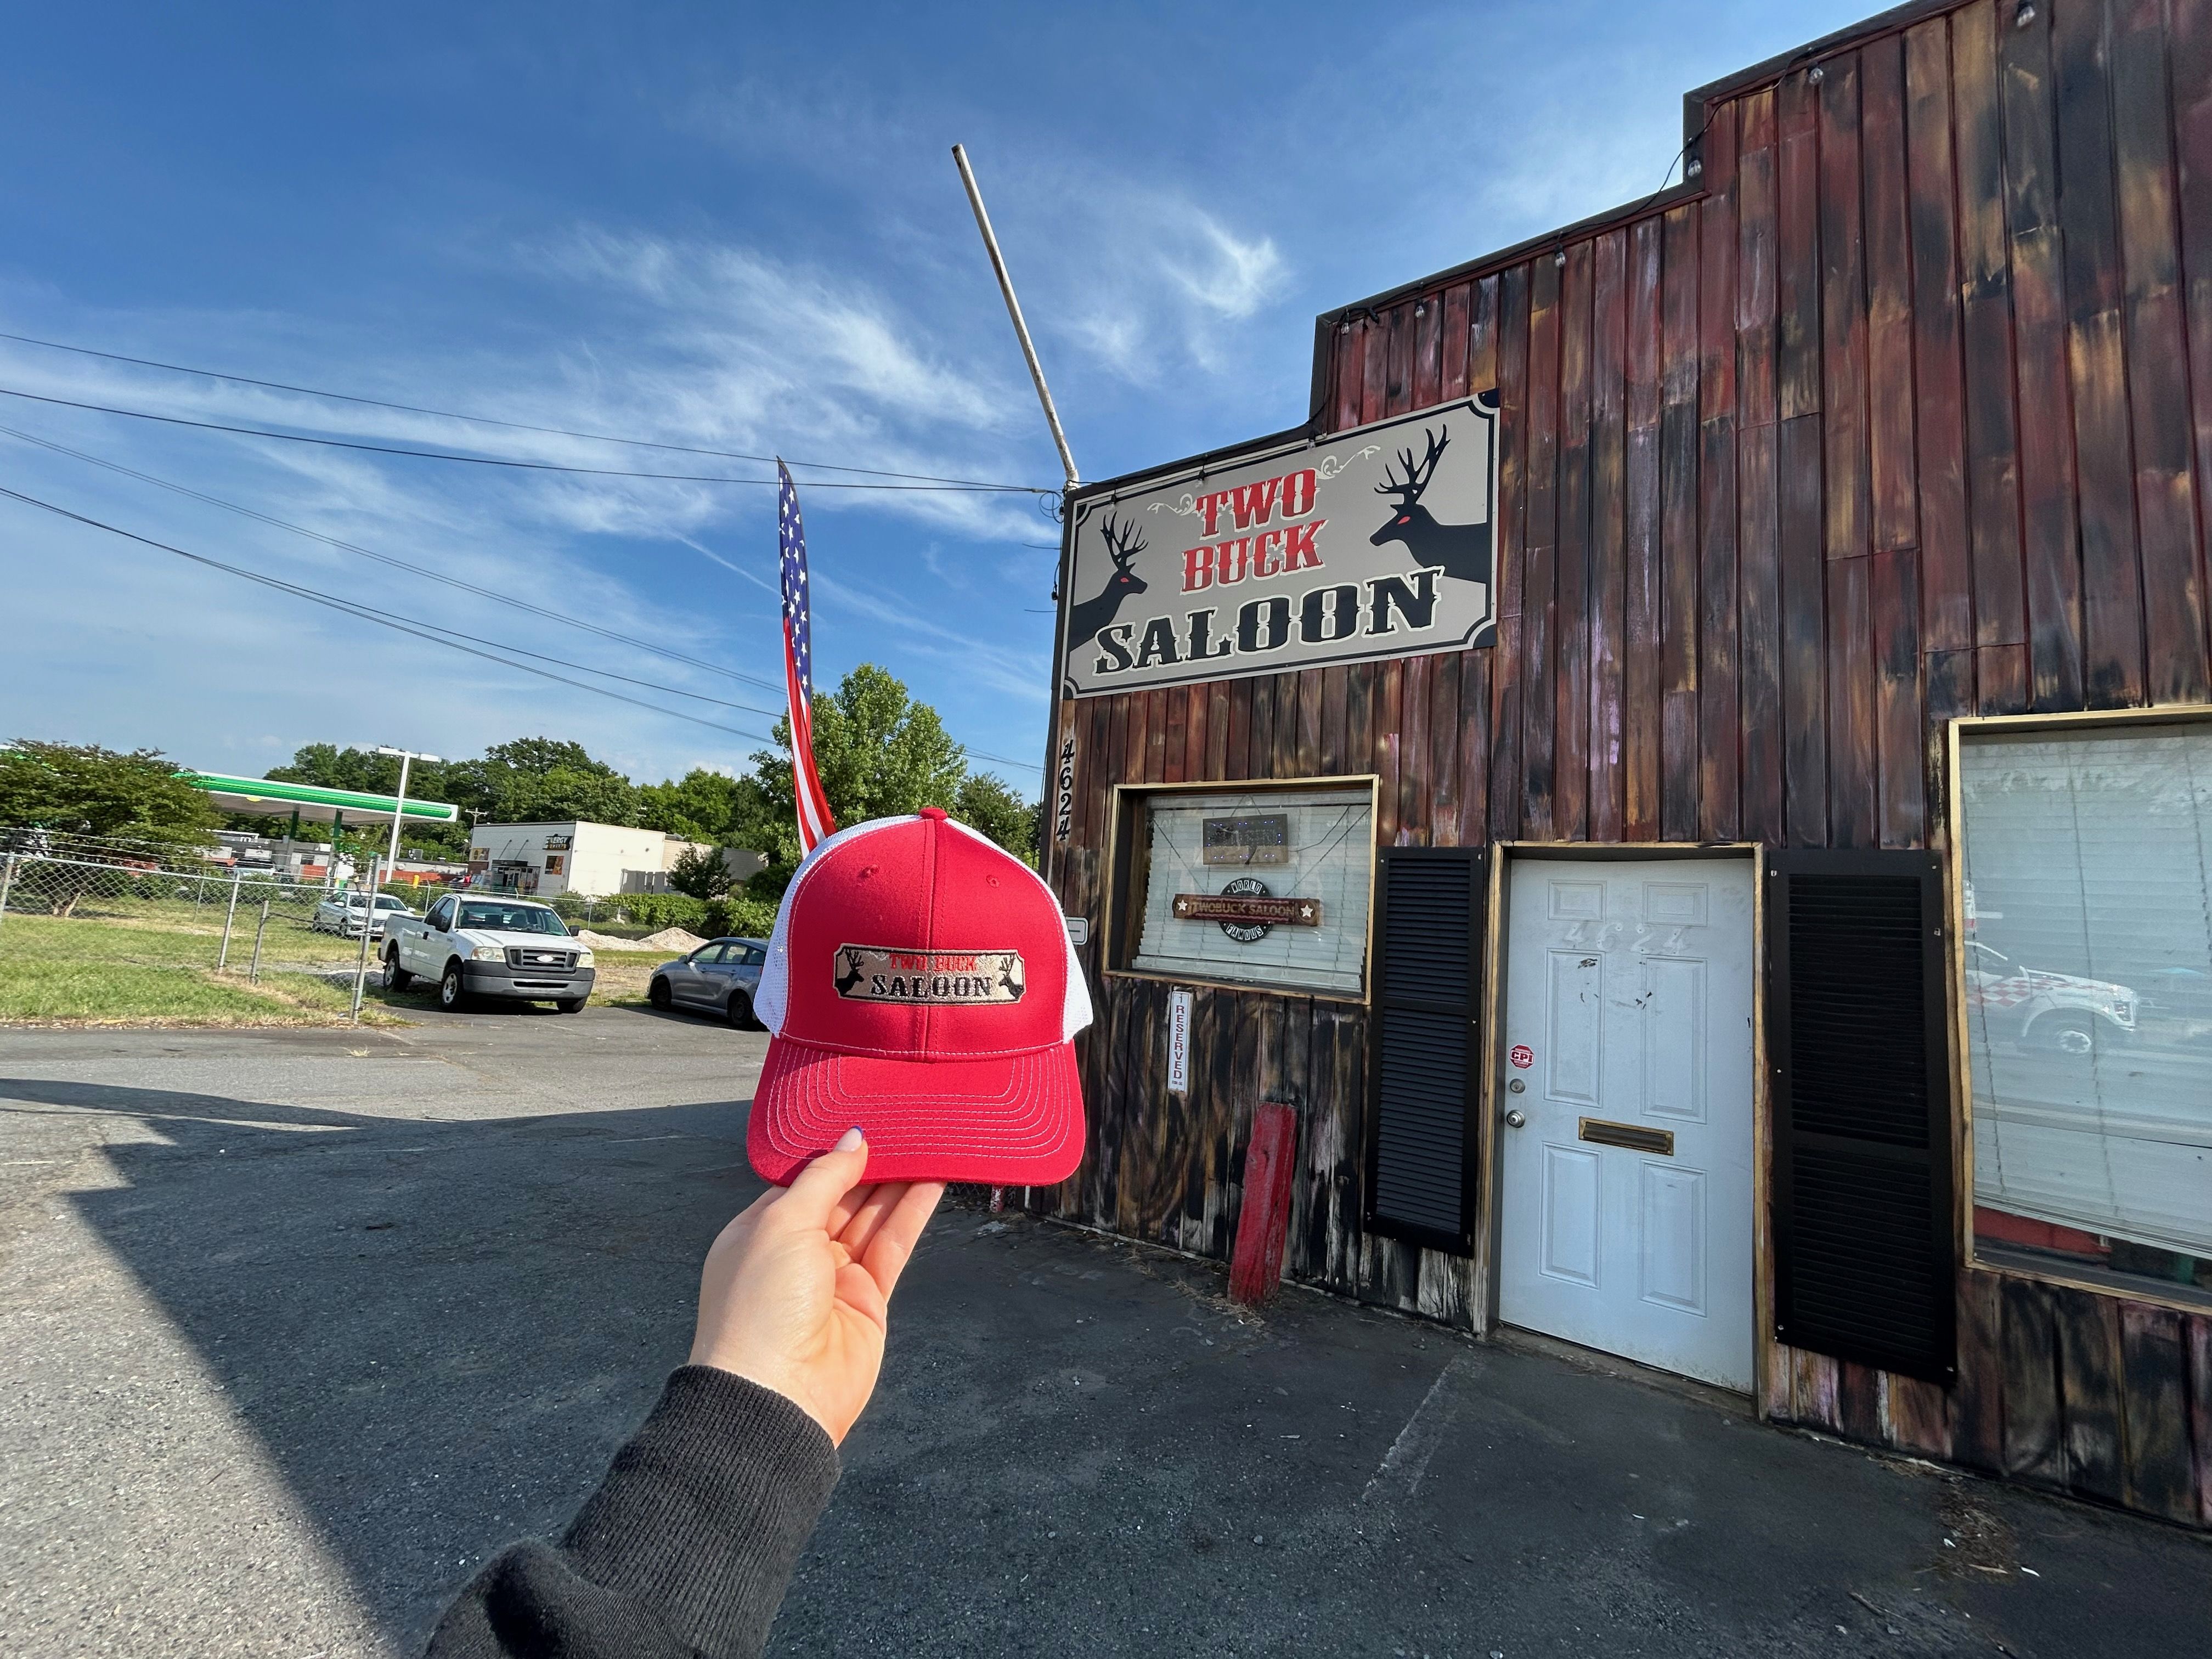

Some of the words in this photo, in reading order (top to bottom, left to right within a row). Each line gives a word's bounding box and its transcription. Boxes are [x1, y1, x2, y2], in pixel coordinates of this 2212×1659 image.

[1193, 467, 1320, 539] TWO
[1180, 519, 1328, 595] BUCK
[1092, 565, 1444, 676] SALOON
[1057, 740, 1075, 841] 4624
[1231, 879, 1263, 895] WORLD
[1226, 924, 1263, 941] FAMOUS
[871, 974, 992, 998] SALOON
[889, 953, 927, 971] TWO
[933, 955, 977, 972] BUCK
[1173, 1005, 1185, 1079] RESERVED
[1511, 1051, 1533, 1063] CPI
